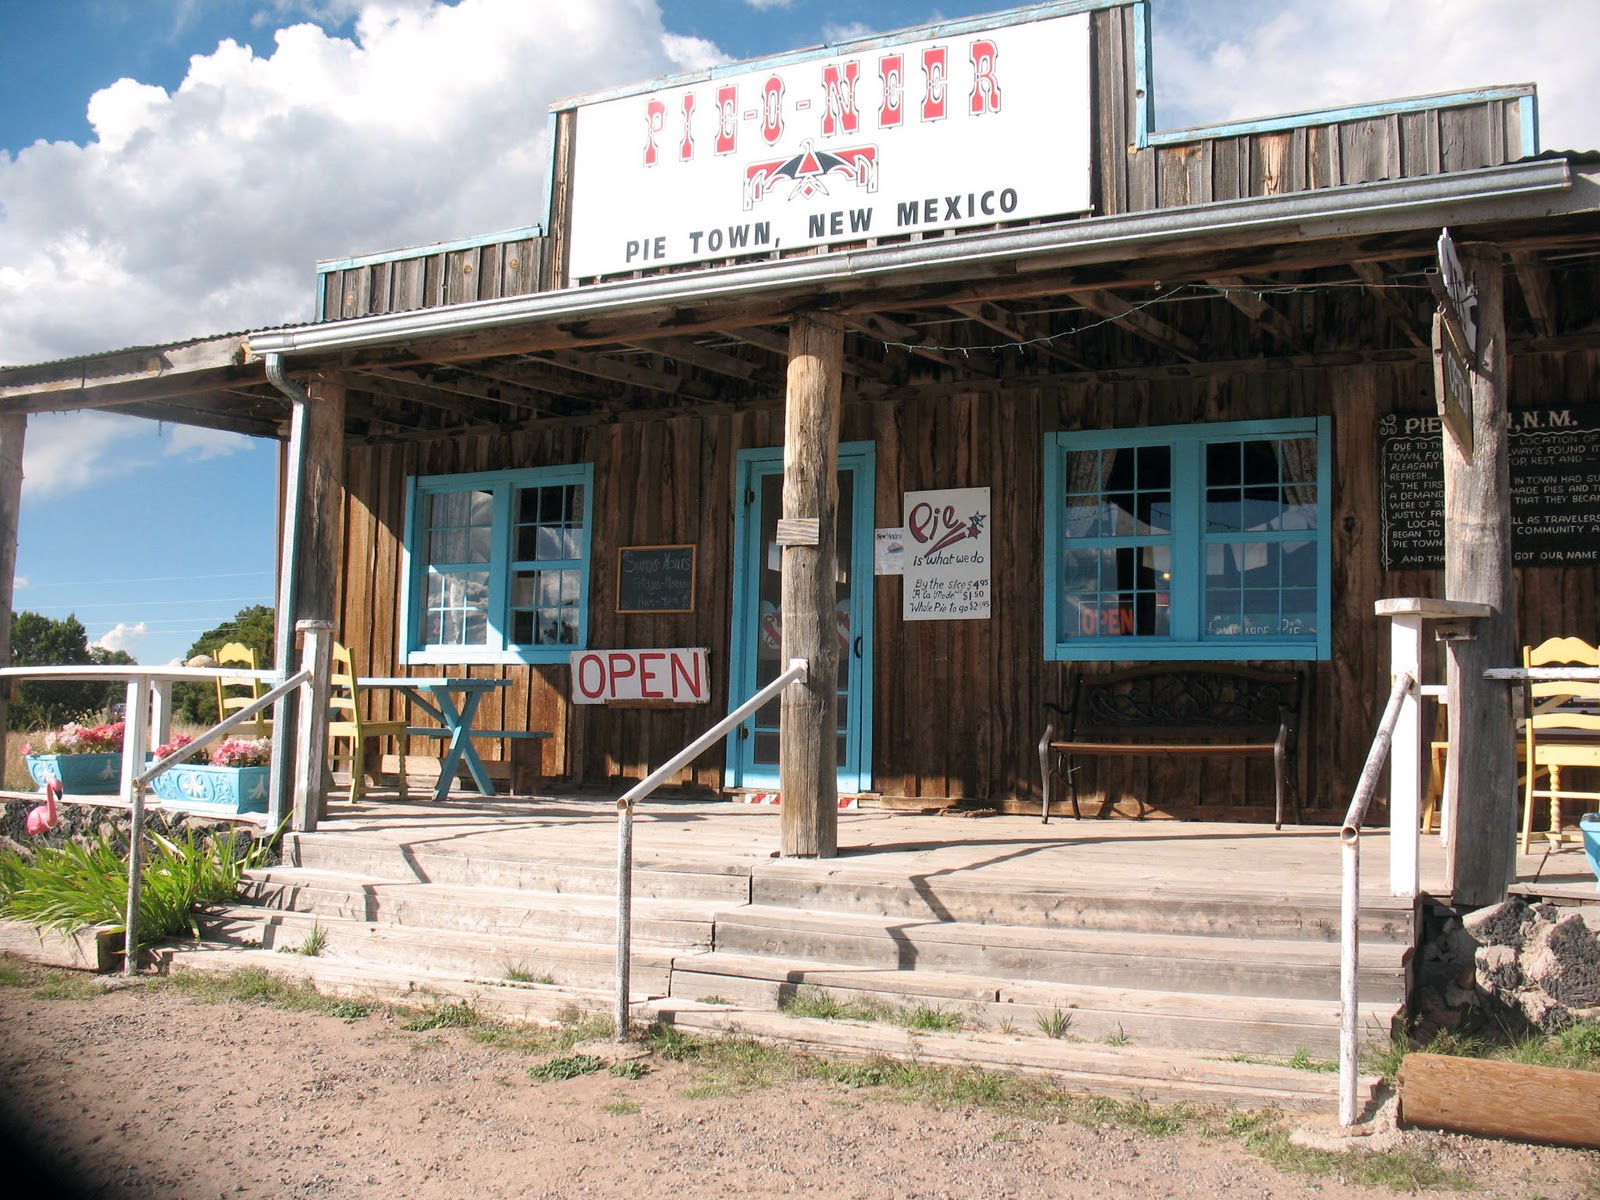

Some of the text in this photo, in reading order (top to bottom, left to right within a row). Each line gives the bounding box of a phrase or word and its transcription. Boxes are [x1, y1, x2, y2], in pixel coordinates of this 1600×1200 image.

[643, 39, 1002, 168] PIE-O-NEER
[626, 188, 1019, 263] PIE TOWN, NEW MEXICO
[1404, 417, 1442, 434] PIE
[1393, 434, 1598, 451] DUE TO TH LOCATION OF
[1507, 446, 1542, 456] WAYS
[1547, 445, 1586, 455] FOUND
[1391, 461, 1440, 471] PLEASANT
[1531, 456, 1555, 465] REST
[1559, 455, 1583, 463] AND
[1400, 482, 1418, 490] THE
[1424, 481, 1445, 489] FIRS
[1514, 476, 1524, 484] IN
[1526, 476, 1557, 484] TOWN
[1560, 475, 1582, 483] HAD
[1509, 486, 1538, 494] MADE
[1544, 485, 1564, 493] PIES
[1568, 484, 1589, 492] AND
[1390, 501, 1415, 510] WERE
[1514, 496, 1540, 504] THAT
[1545, 495, 1568, 504] THEY
[1392, 510, 1426, 519] JUSTLY
[1407, 514, 1600, 528] LOCAL ELL AS TRAVELERS
[909, 502, 959, 544] Pie
[1392, 530, 1422, 539] BEGAN
[1427, 529, 1440, 537] TO
[1517, 525, 1585, 535] COMMUNITY
[913, 550, 984, 566] is what we do
[1401, 551, 1598, 564] AND THA GOT OUR NAME
[915, 579, 929, 590] By
[929, 578, 944, 589] the
[934, 602, 947, 612] Pie
[949, 602, 956, 612] to
[958, 604, 968, 613] go
[1081, 608, 1134, 635] OPEN
[579, 652, 701, 698] OPEN
